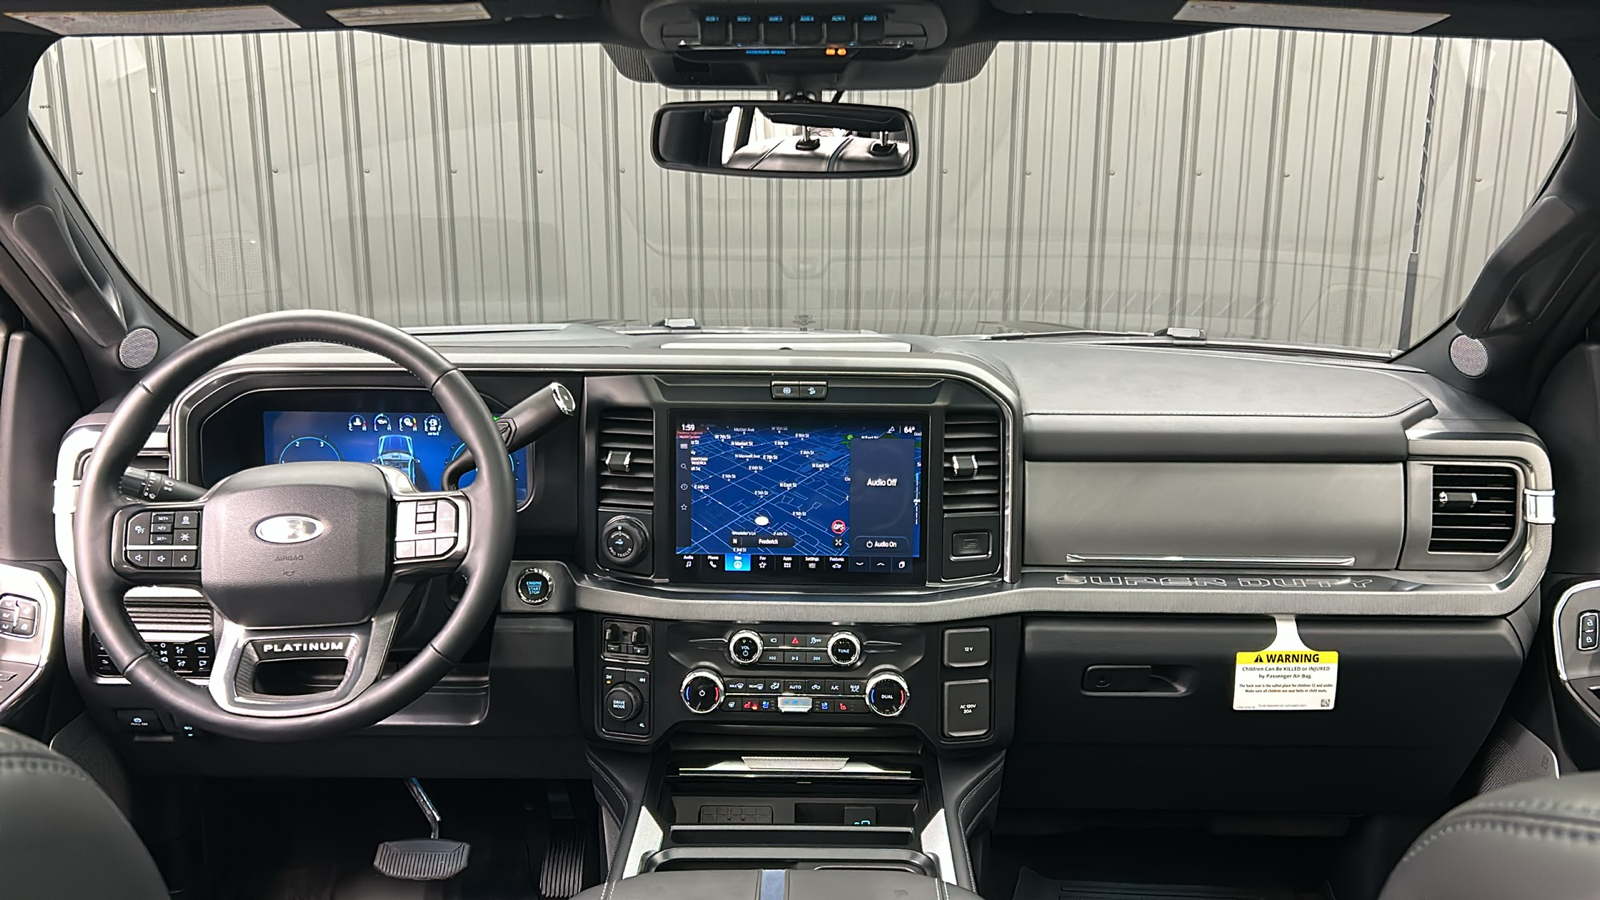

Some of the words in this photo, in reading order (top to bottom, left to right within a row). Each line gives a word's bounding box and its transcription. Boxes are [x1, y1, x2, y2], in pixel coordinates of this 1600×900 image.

[867, 478, 886, 486] Audio
[886, 478, 897, 486] Off
[1056, 574, 1228, 587] SUPER
[1238, 577, 1373, 588] DUTY
[263, 642, 344, 653] PLATINUM
[1266, 654, 1320, 663] WARNING
